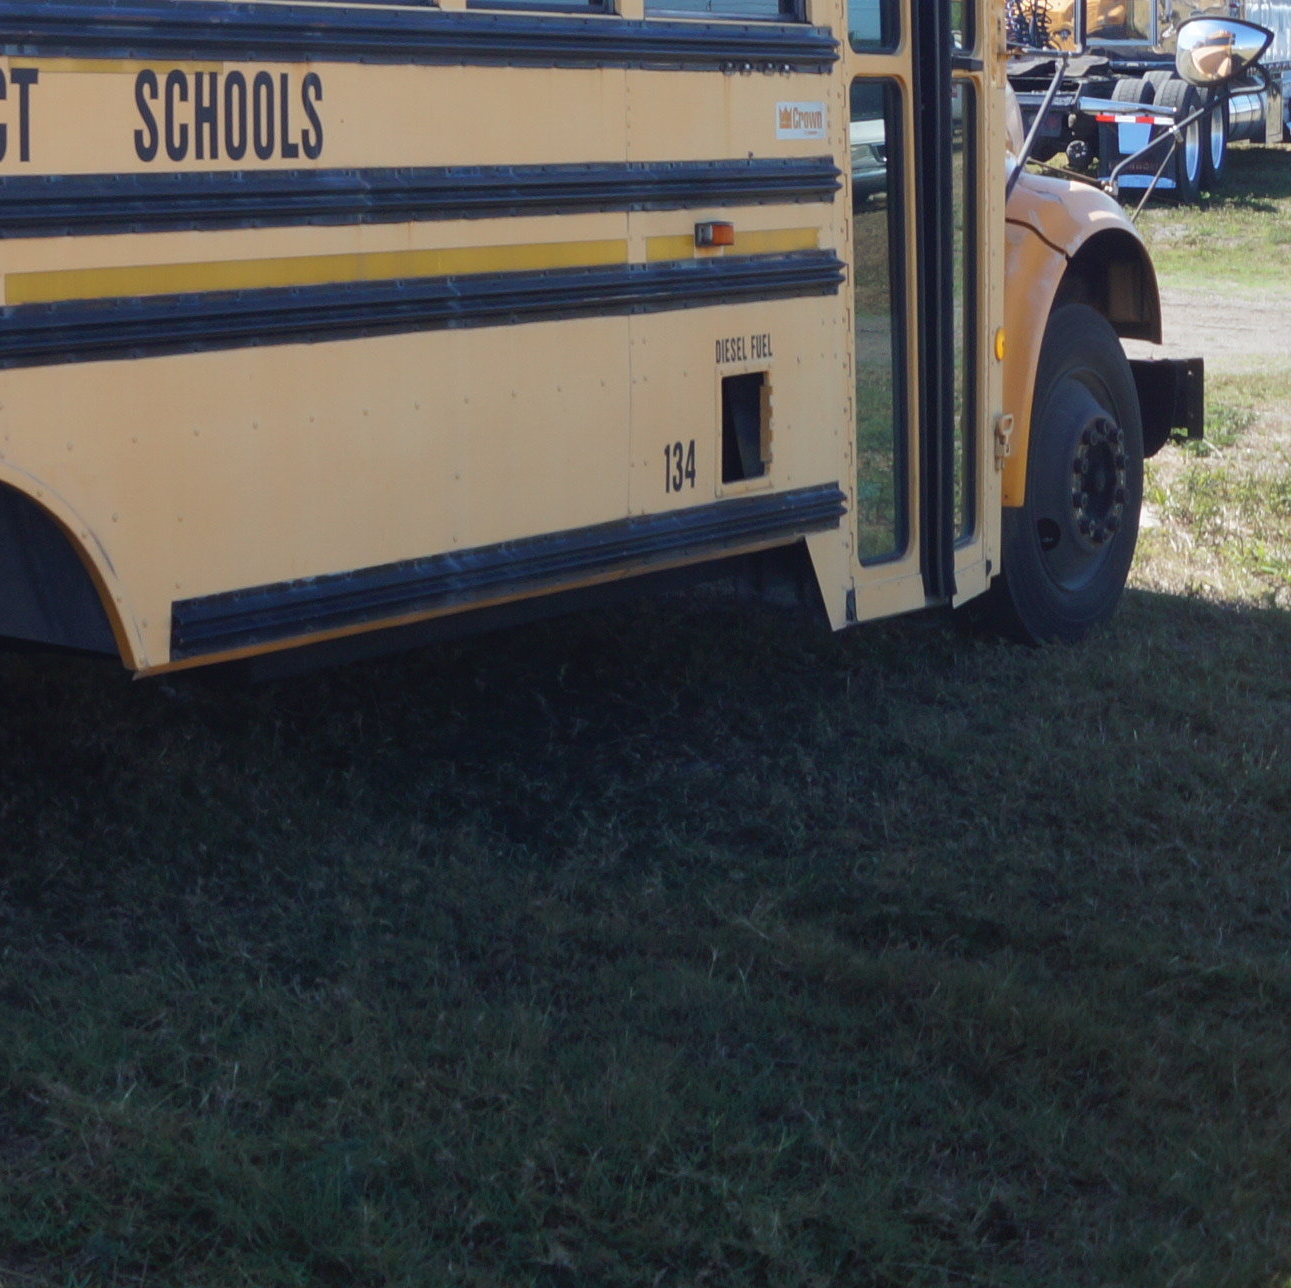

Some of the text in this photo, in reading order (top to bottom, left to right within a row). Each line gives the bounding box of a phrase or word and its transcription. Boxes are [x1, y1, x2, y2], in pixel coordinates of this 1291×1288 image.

[134, 68, 324, 164] SCHOOLS
[793, 107, 823, 129] Crown
[715, 333, 773, 364] DIESEL FUEL
[664, 439, 696, 493] 134
